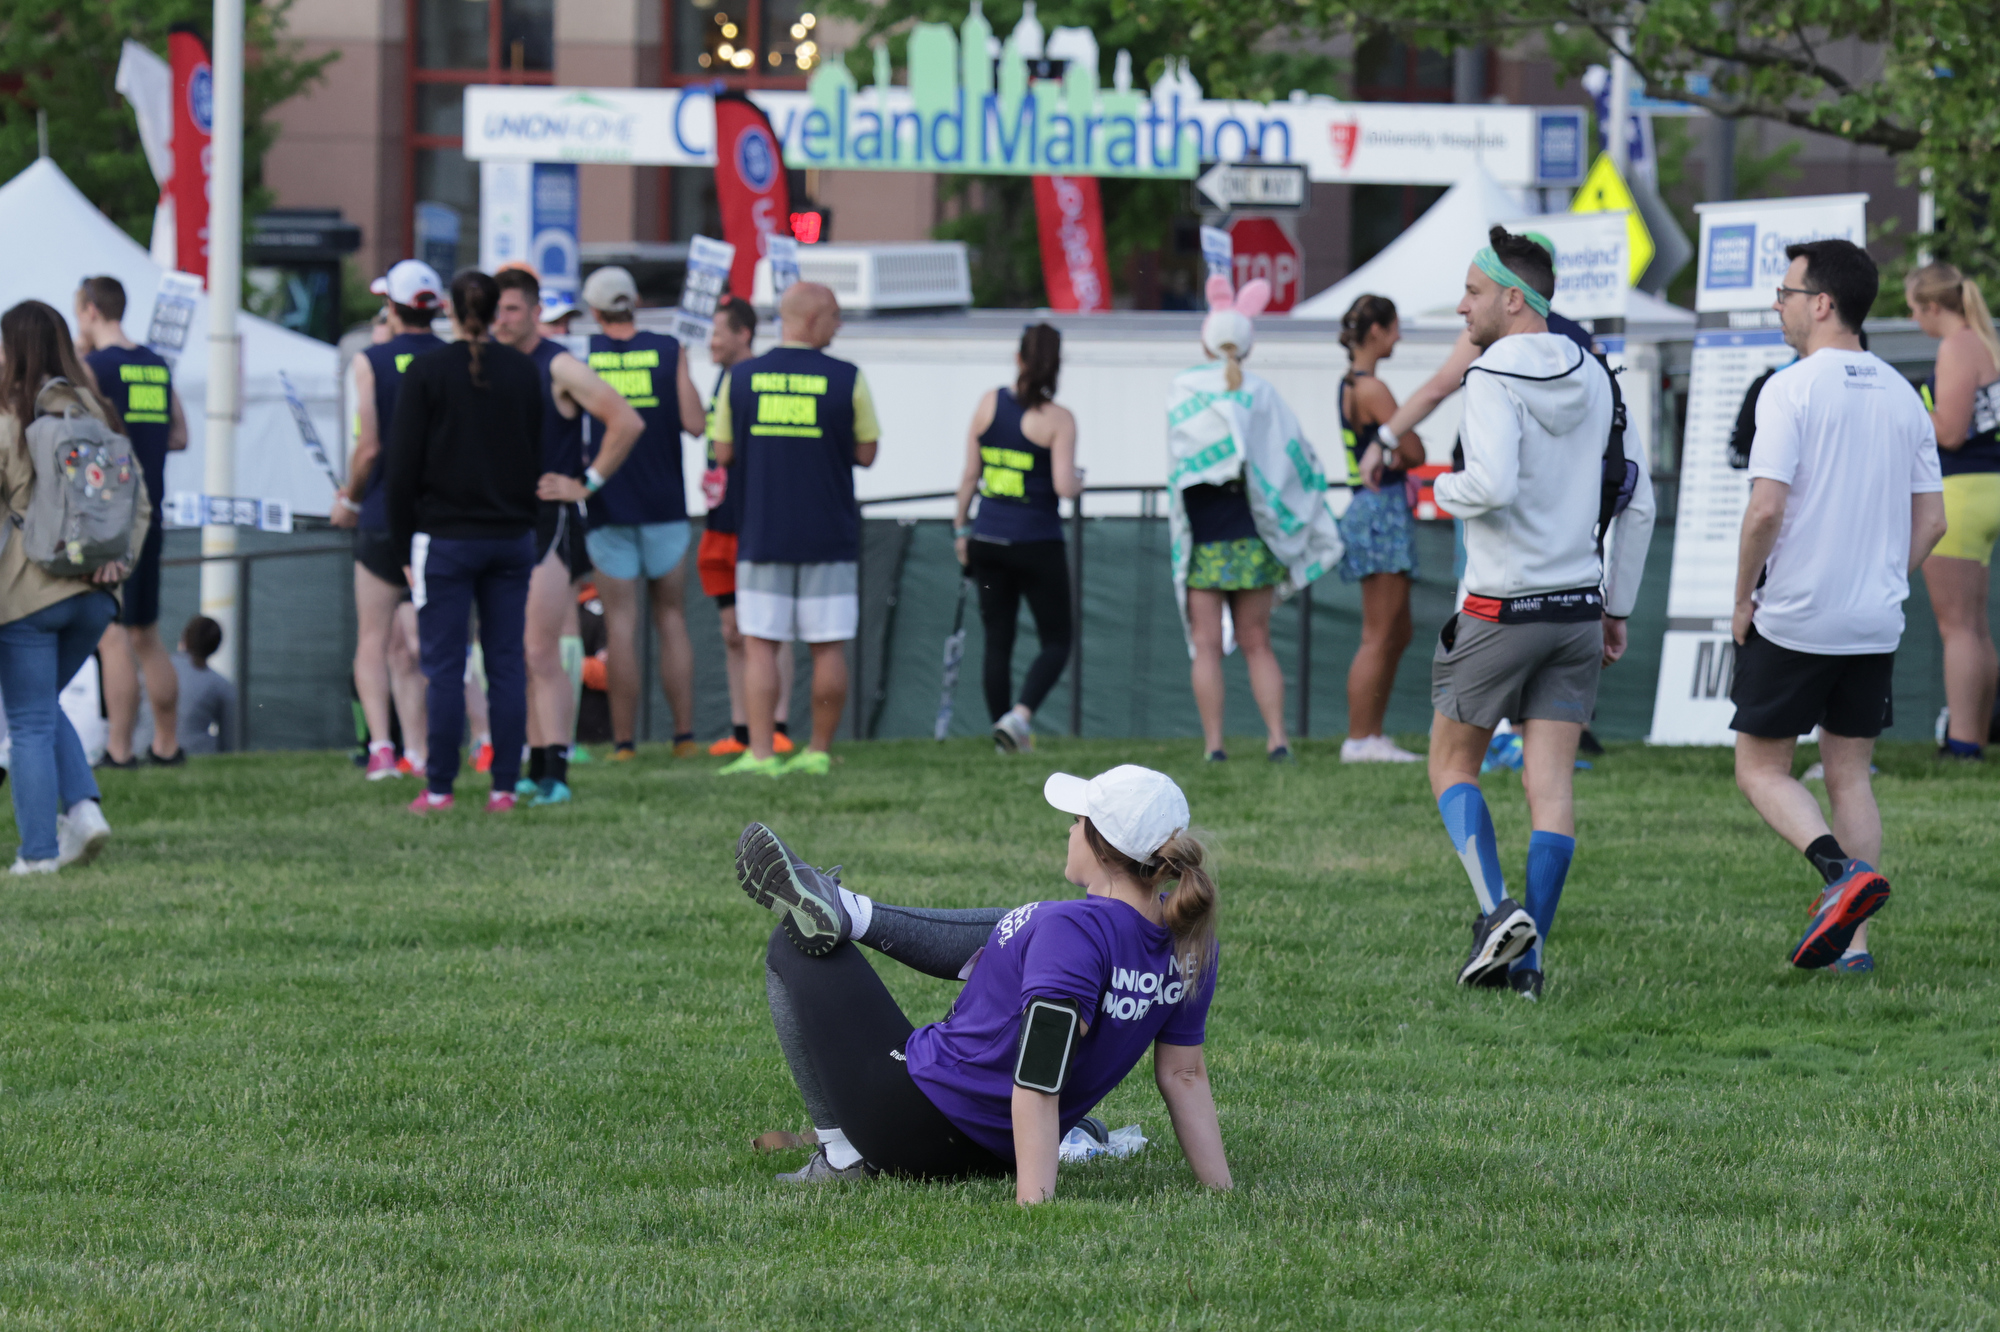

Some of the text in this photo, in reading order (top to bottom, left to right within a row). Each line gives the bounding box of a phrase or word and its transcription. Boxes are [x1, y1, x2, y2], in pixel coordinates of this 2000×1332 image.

[674, 82, 1290, 167] Cveland Marathon
[1219, 173, 1295, 197] ONE WAY
[1233, 253, 1296, 303] TOP
[788, 374, 828, 395] TEAM
